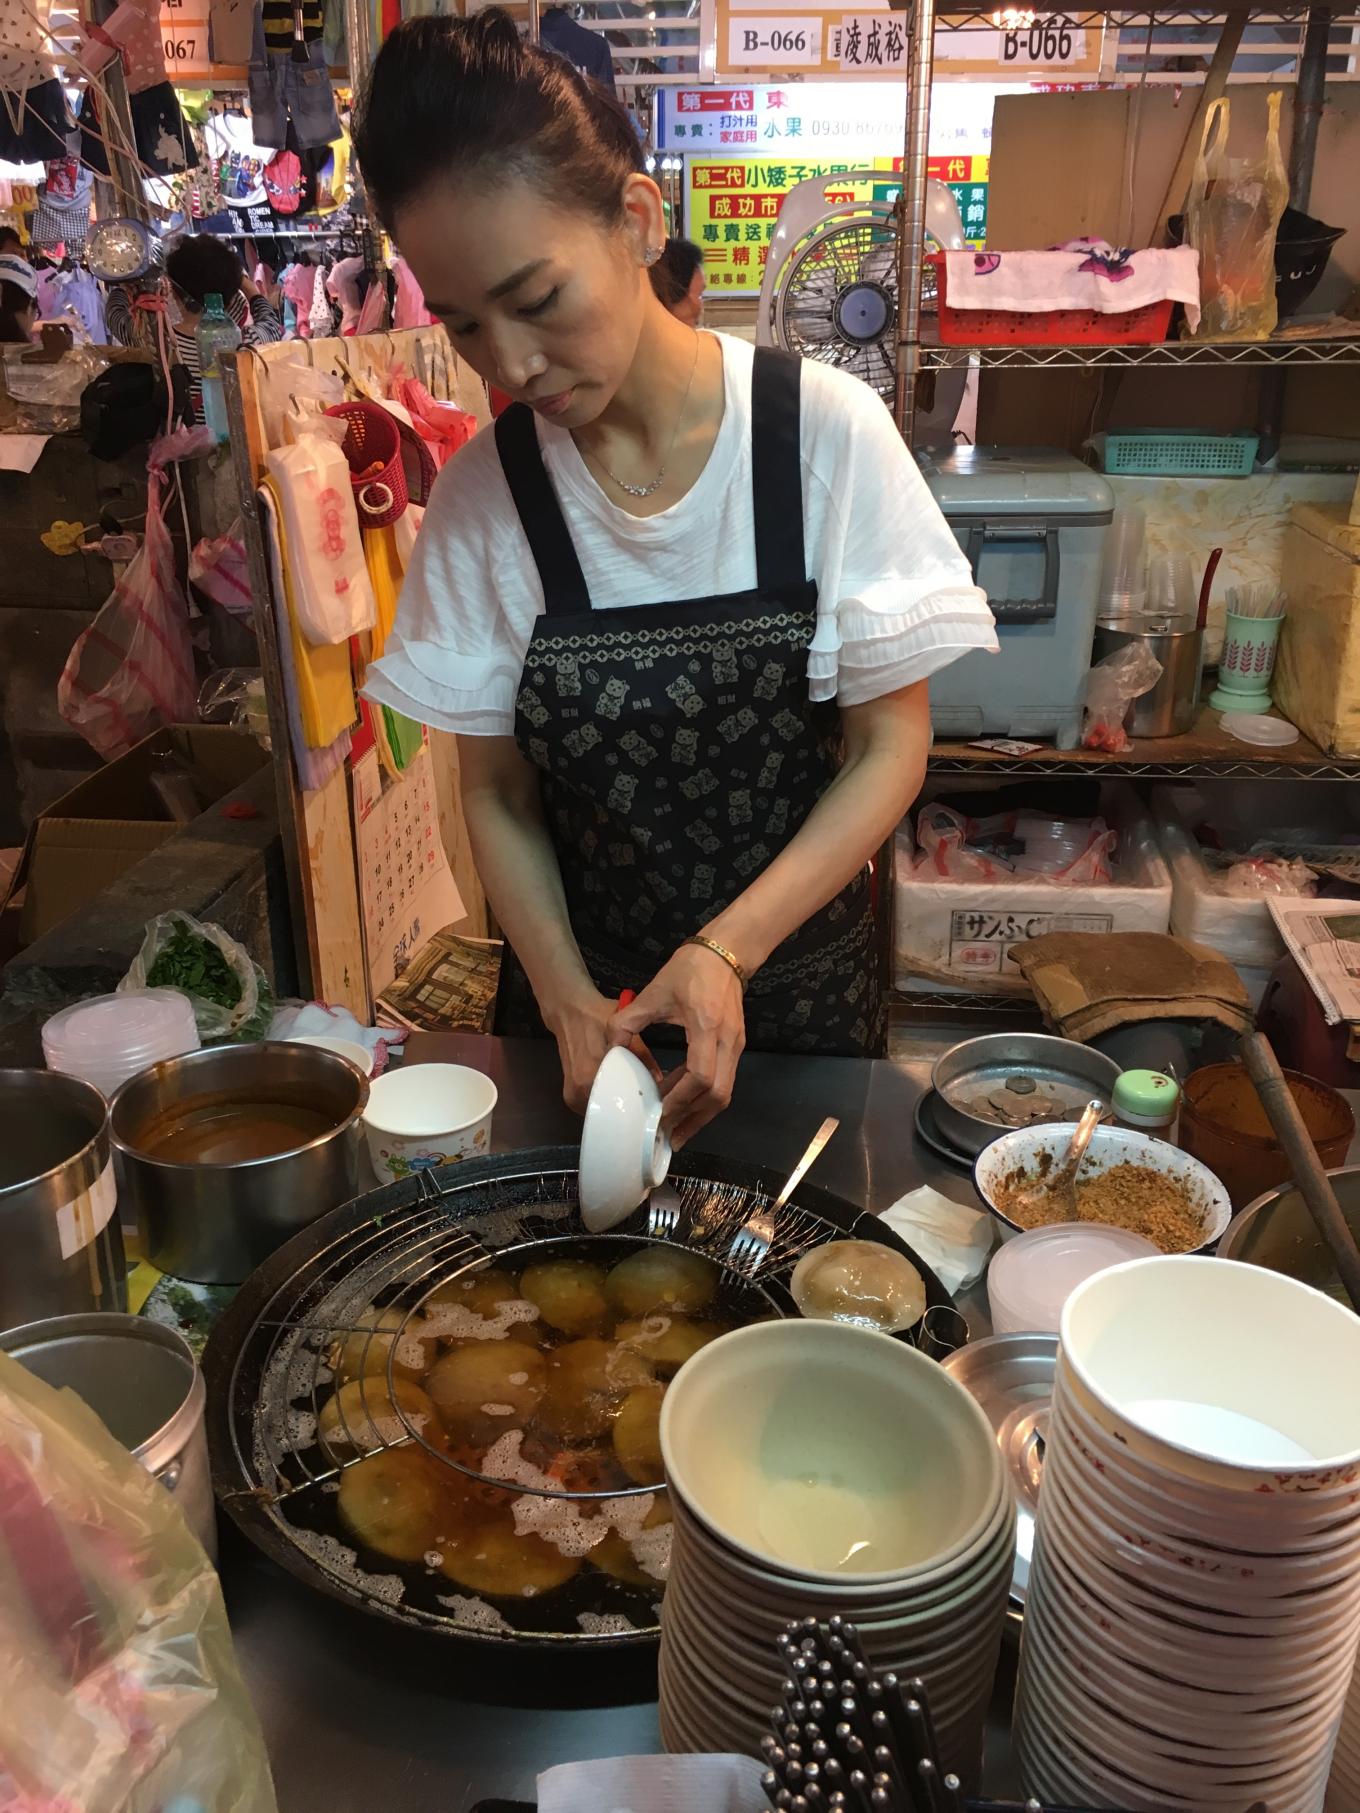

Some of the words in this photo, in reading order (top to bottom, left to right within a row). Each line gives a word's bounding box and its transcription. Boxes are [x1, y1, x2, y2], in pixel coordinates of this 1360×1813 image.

[743, 30, 806, 51] B-066
[844, 18, 904, 65] 凌成裕
[1004, 18, 1072, 61] B-066
[681, 92, 750, 111] 第一代
[720, 114, 758, 129] 打汁用
[720, 130, 758, 143] 家庭用
[695, 168, 742, 186] 第二代
